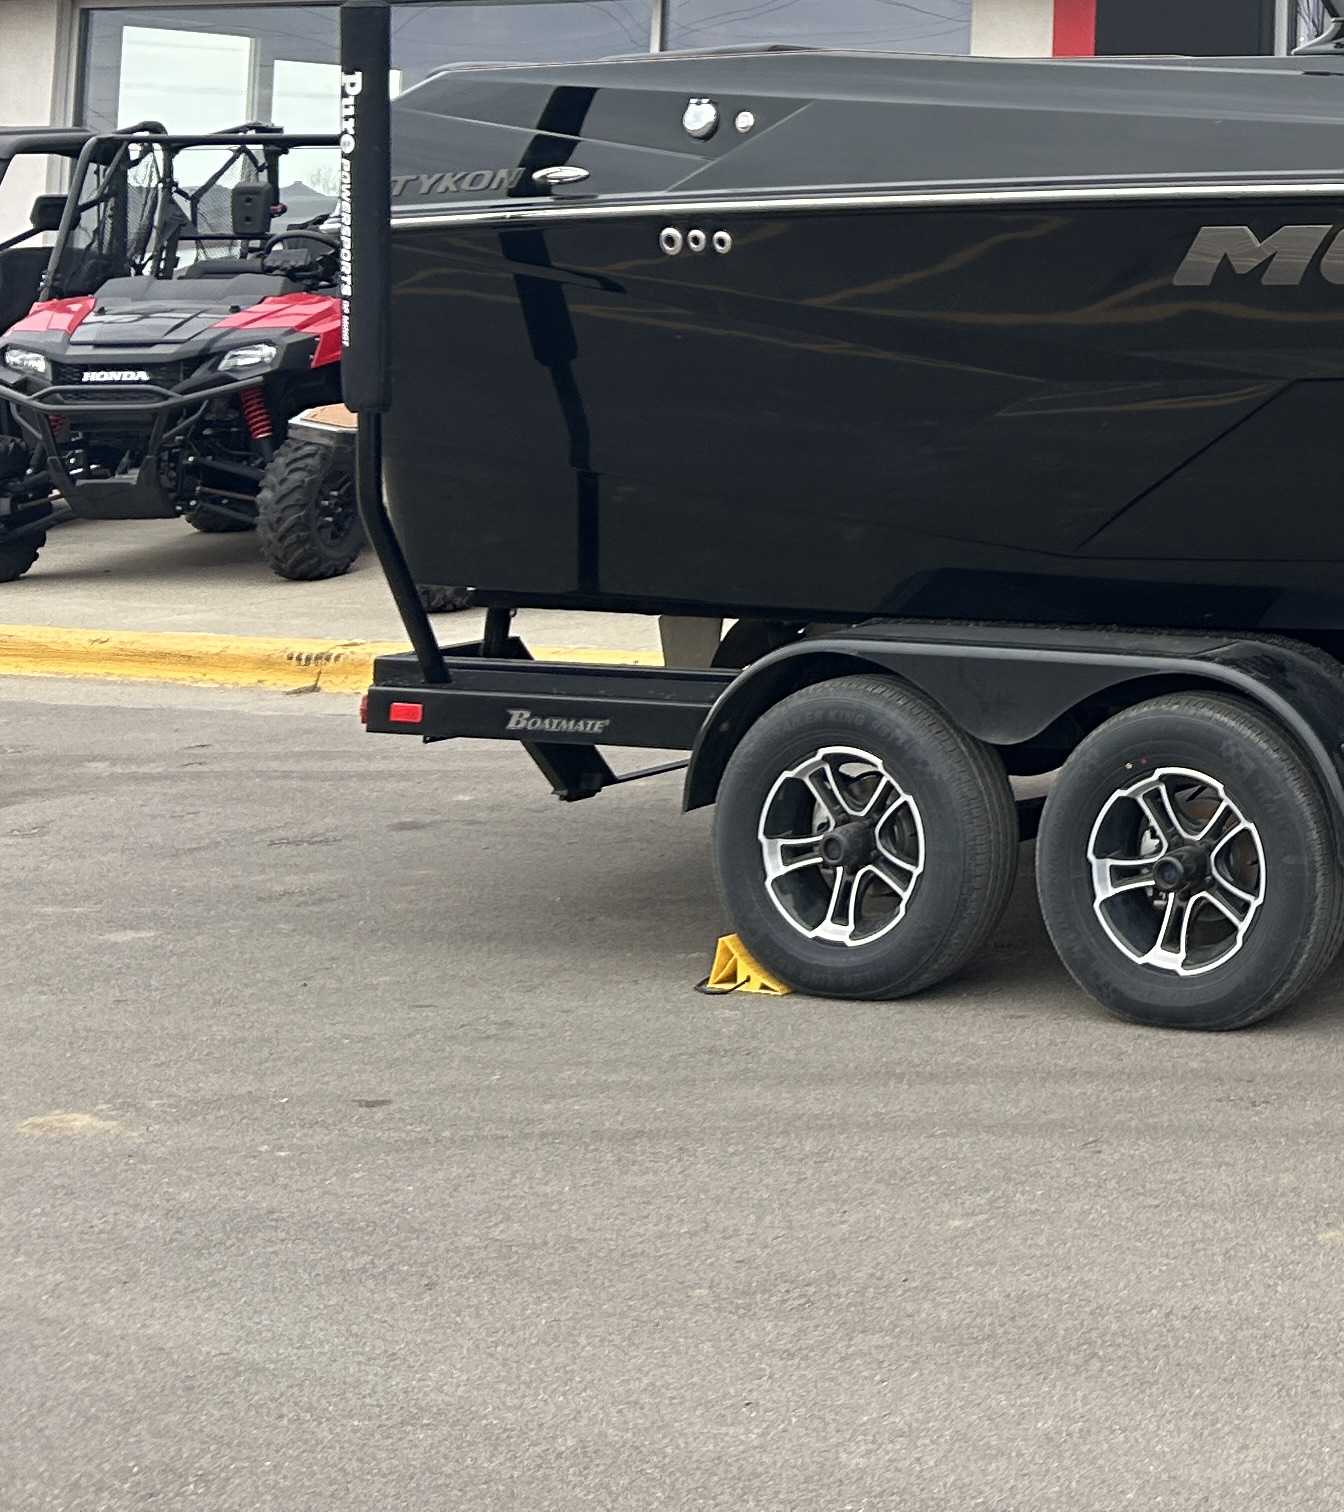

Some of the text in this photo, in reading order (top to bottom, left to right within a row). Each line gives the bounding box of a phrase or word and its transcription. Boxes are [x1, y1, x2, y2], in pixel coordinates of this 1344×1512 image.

[391, 167, 526, 197] TYKON
[341, 158, 352, 297] POWERSPORTS
[81, 371, 150, 382] HONDA
